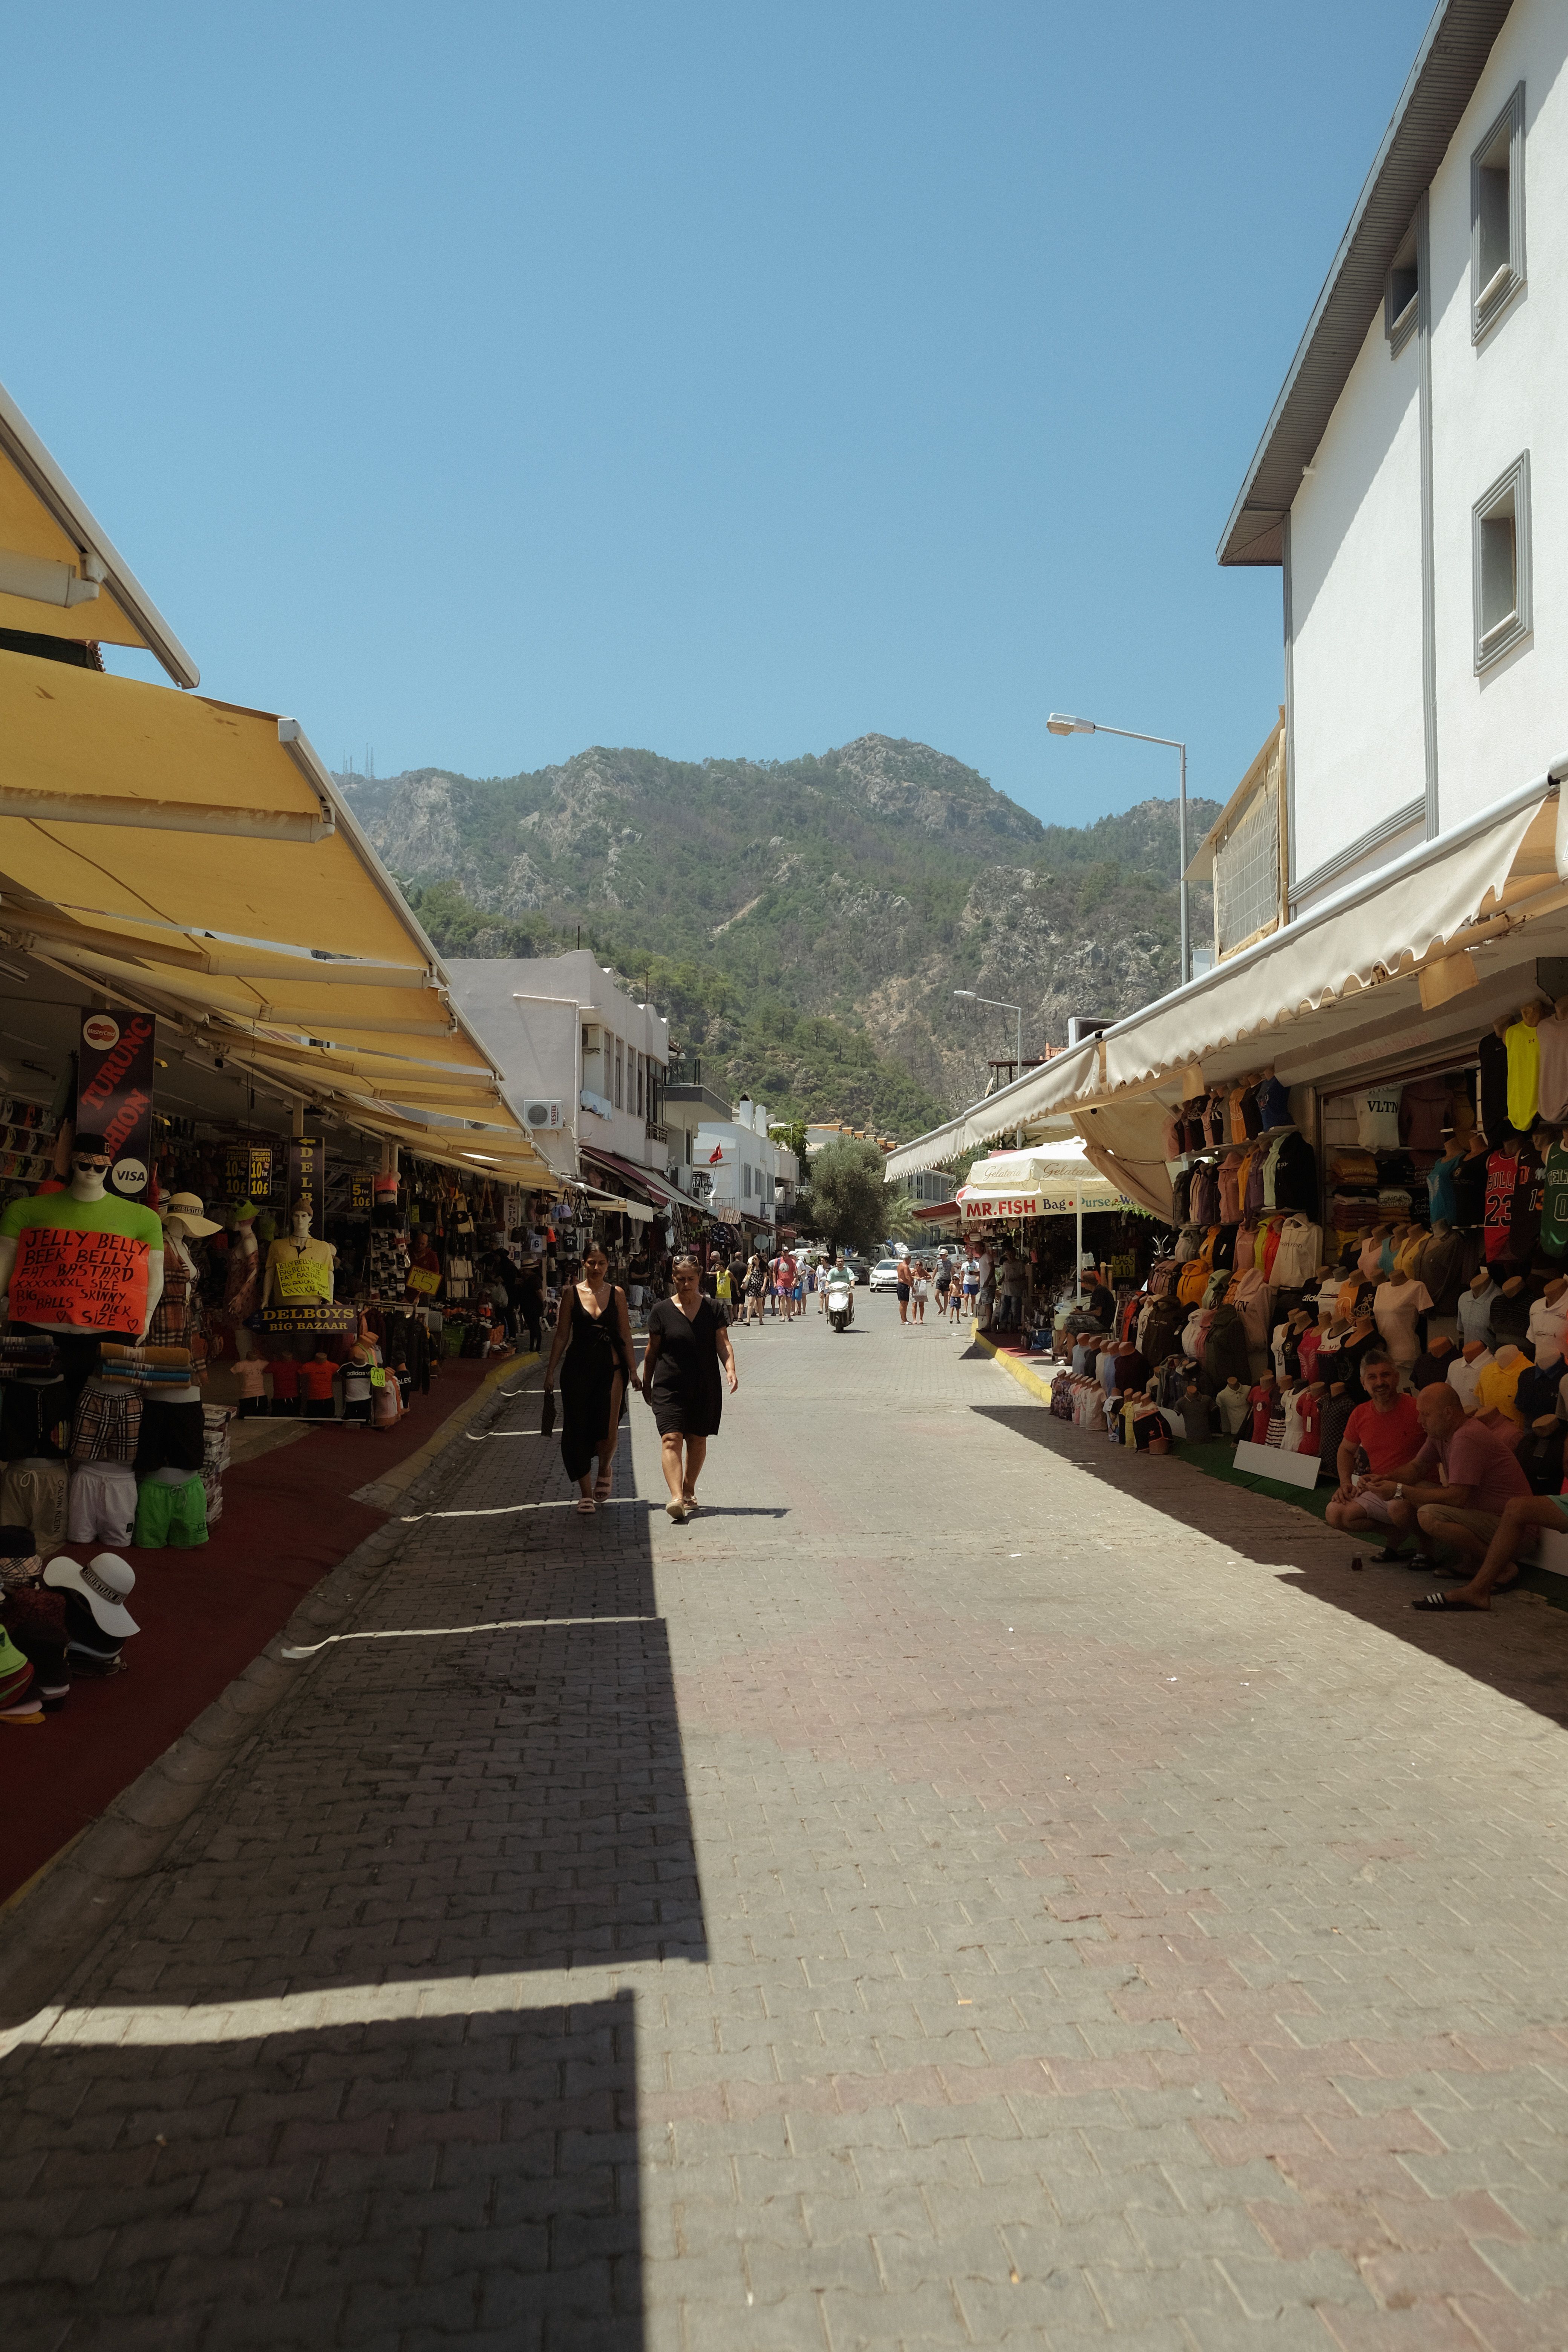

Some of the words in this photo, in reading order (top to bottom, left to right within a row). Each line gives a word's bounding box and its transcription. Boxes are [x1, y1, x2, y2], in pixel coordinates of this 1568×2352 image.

[87, 1028, 116, 1037] MasterCard
[1367, 1101, 1398, 1113] VLTN
[103, 1087, 150, 1160] HION
[115, 1170, 145, 1182] VISA
[225, 1161, 238, 1177] 10
[251, 1161, 262, 1178] 10
[983, 1166, 1022, 1182] Gelateria
[1043, 1163, 1099, 1178] Gelateria
[251, 1180, 268, 1194] 10£
[352, 1184, 361, 1196] 5
[352, 1197, 370, 1207] 10£
[1043, 1199, 1066, 1211] Bag
[173, 1206, 203, 1216] CHRISTIAN
[1484, 1194, 1514, 1227] 23
[26, 1230, 89, 1248] JELLY
[97, 1234, 149, 1256] BELLY
[24, 1247, 67, 1265] BEER
[76, 1250, 133, 1267] BELLY
[1115, 1255, 1134, 1265] BAGS
[278, 1261, 293, 1269] JELLY
[18, 1265, 49, 1279] FAT
[56, 1263, 134, 1282] BASTARD
[90, 1279, 119, 1291] SIZE
[410, 1273, 435, 1291] £5
[79, 1289, 126, 1303] SKINNY
[262, 1308, 354, 1320] DELBOYS
[297, 1322, 348, 1331] BAZAAR
[371, 1368, 376, 1378] 2
[54, 1510, 62, 1532] KLEIN
[83, 1569, 116, 1599] CHRISTIAN
